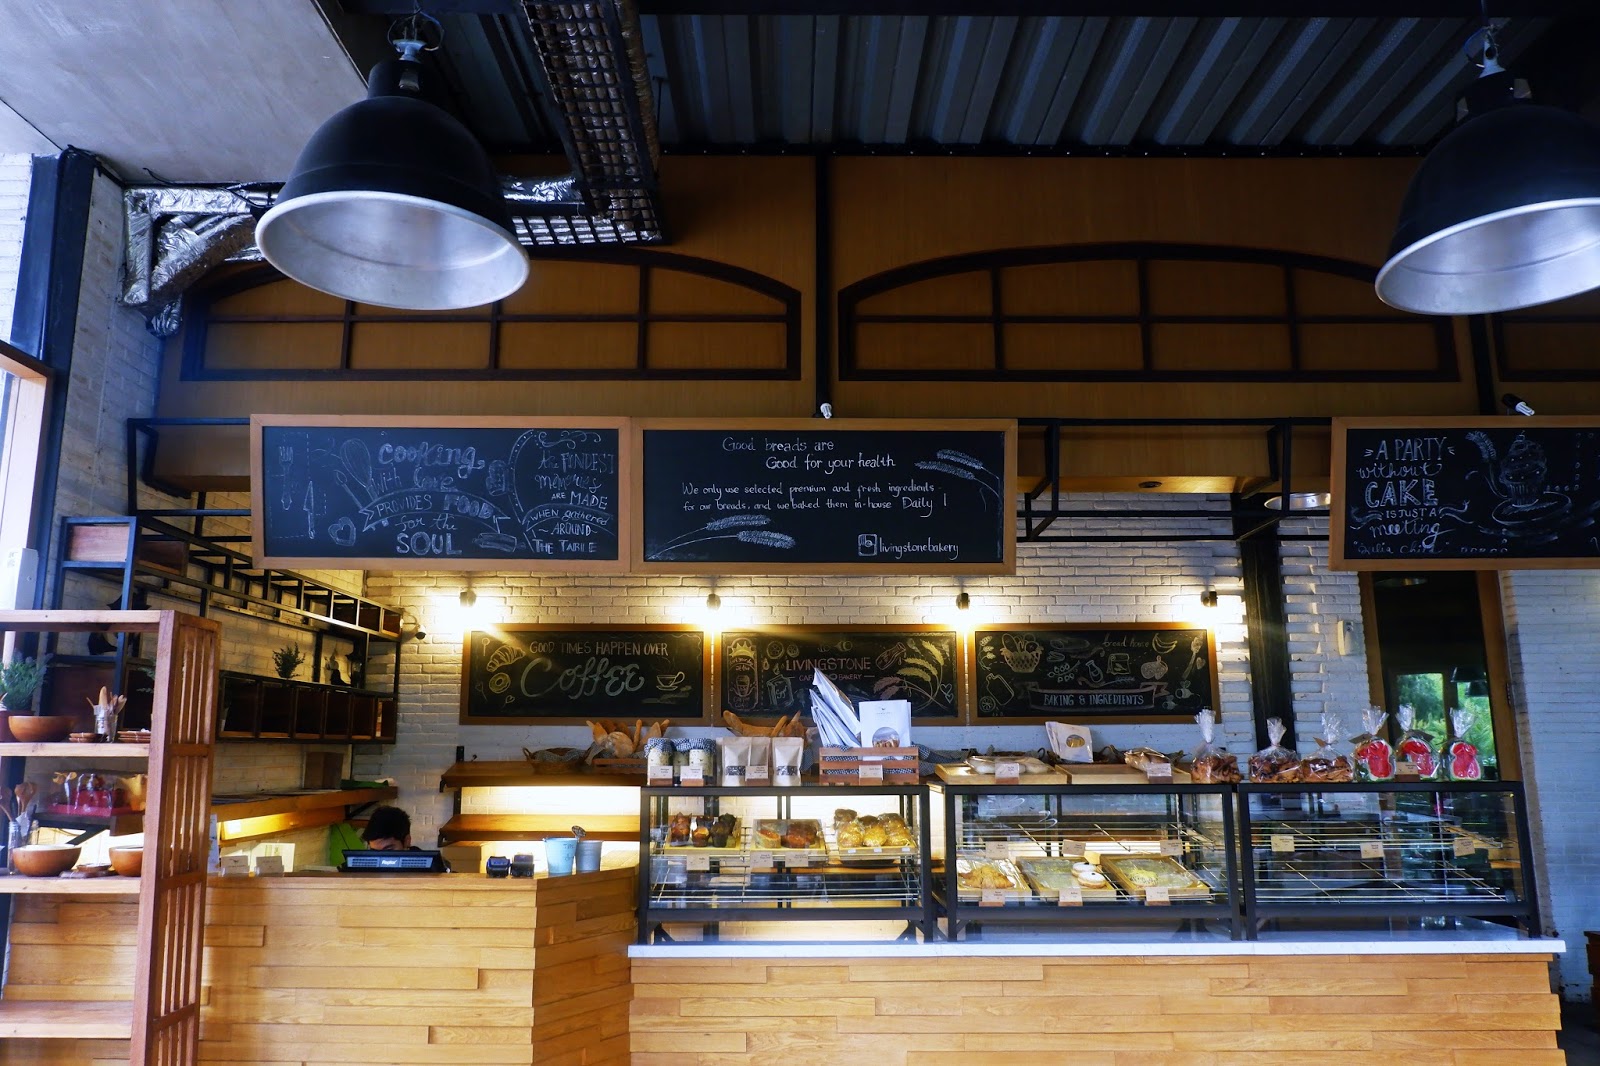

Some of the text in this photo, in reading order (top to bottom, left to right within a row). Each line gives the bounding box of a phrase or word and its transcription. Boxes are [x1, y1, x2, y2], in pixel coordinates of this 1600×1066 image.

[722, 437, 834, 452] Good breads are
[1375, 436, 1448, 461] A PARTY
[766, 452, 897, 475] Good for your health
[1356, 462, 1443, 479] without
[682, 479, 935, 500] We only use selected premium and fresh ingredients
[1364, 478, 1439, 508] CAKE
[375, 494, 432, 517] PROVIDES
[550, 491, 608, 510] ARE MADE
[683, 501, 695, 511] for
[699, 503, 712, 511] our
[753, 499, 772, 510] and
[776, 502, 790, 510] we
[791, 498, 820, 510] baked
[825, 498, 848, 509] them
[854, 497, 893, 509] in-house
[902, 496, 933, 518] Daily
[395, 512, 458, 532] for the
[530, 509, 609, 526] WHEN gathered
[1386, 508, 1437, 519] IS JUST A
[550, 522, 592, 536] AROUND
[1369, 518, 1446, 549] meeting
[396, 531, 463, 556] SOUL
[532, 539, 554, 554] THE
[879, 536, 960, 561] livingstonebakery
[529, 641, 669, 656] GOOD TIMES HAPPEN OVER
[785, 656, 872, 671] LIVINGSTONE
[1043, 693, 1144, 706] BAKING & INGREDIENTS
